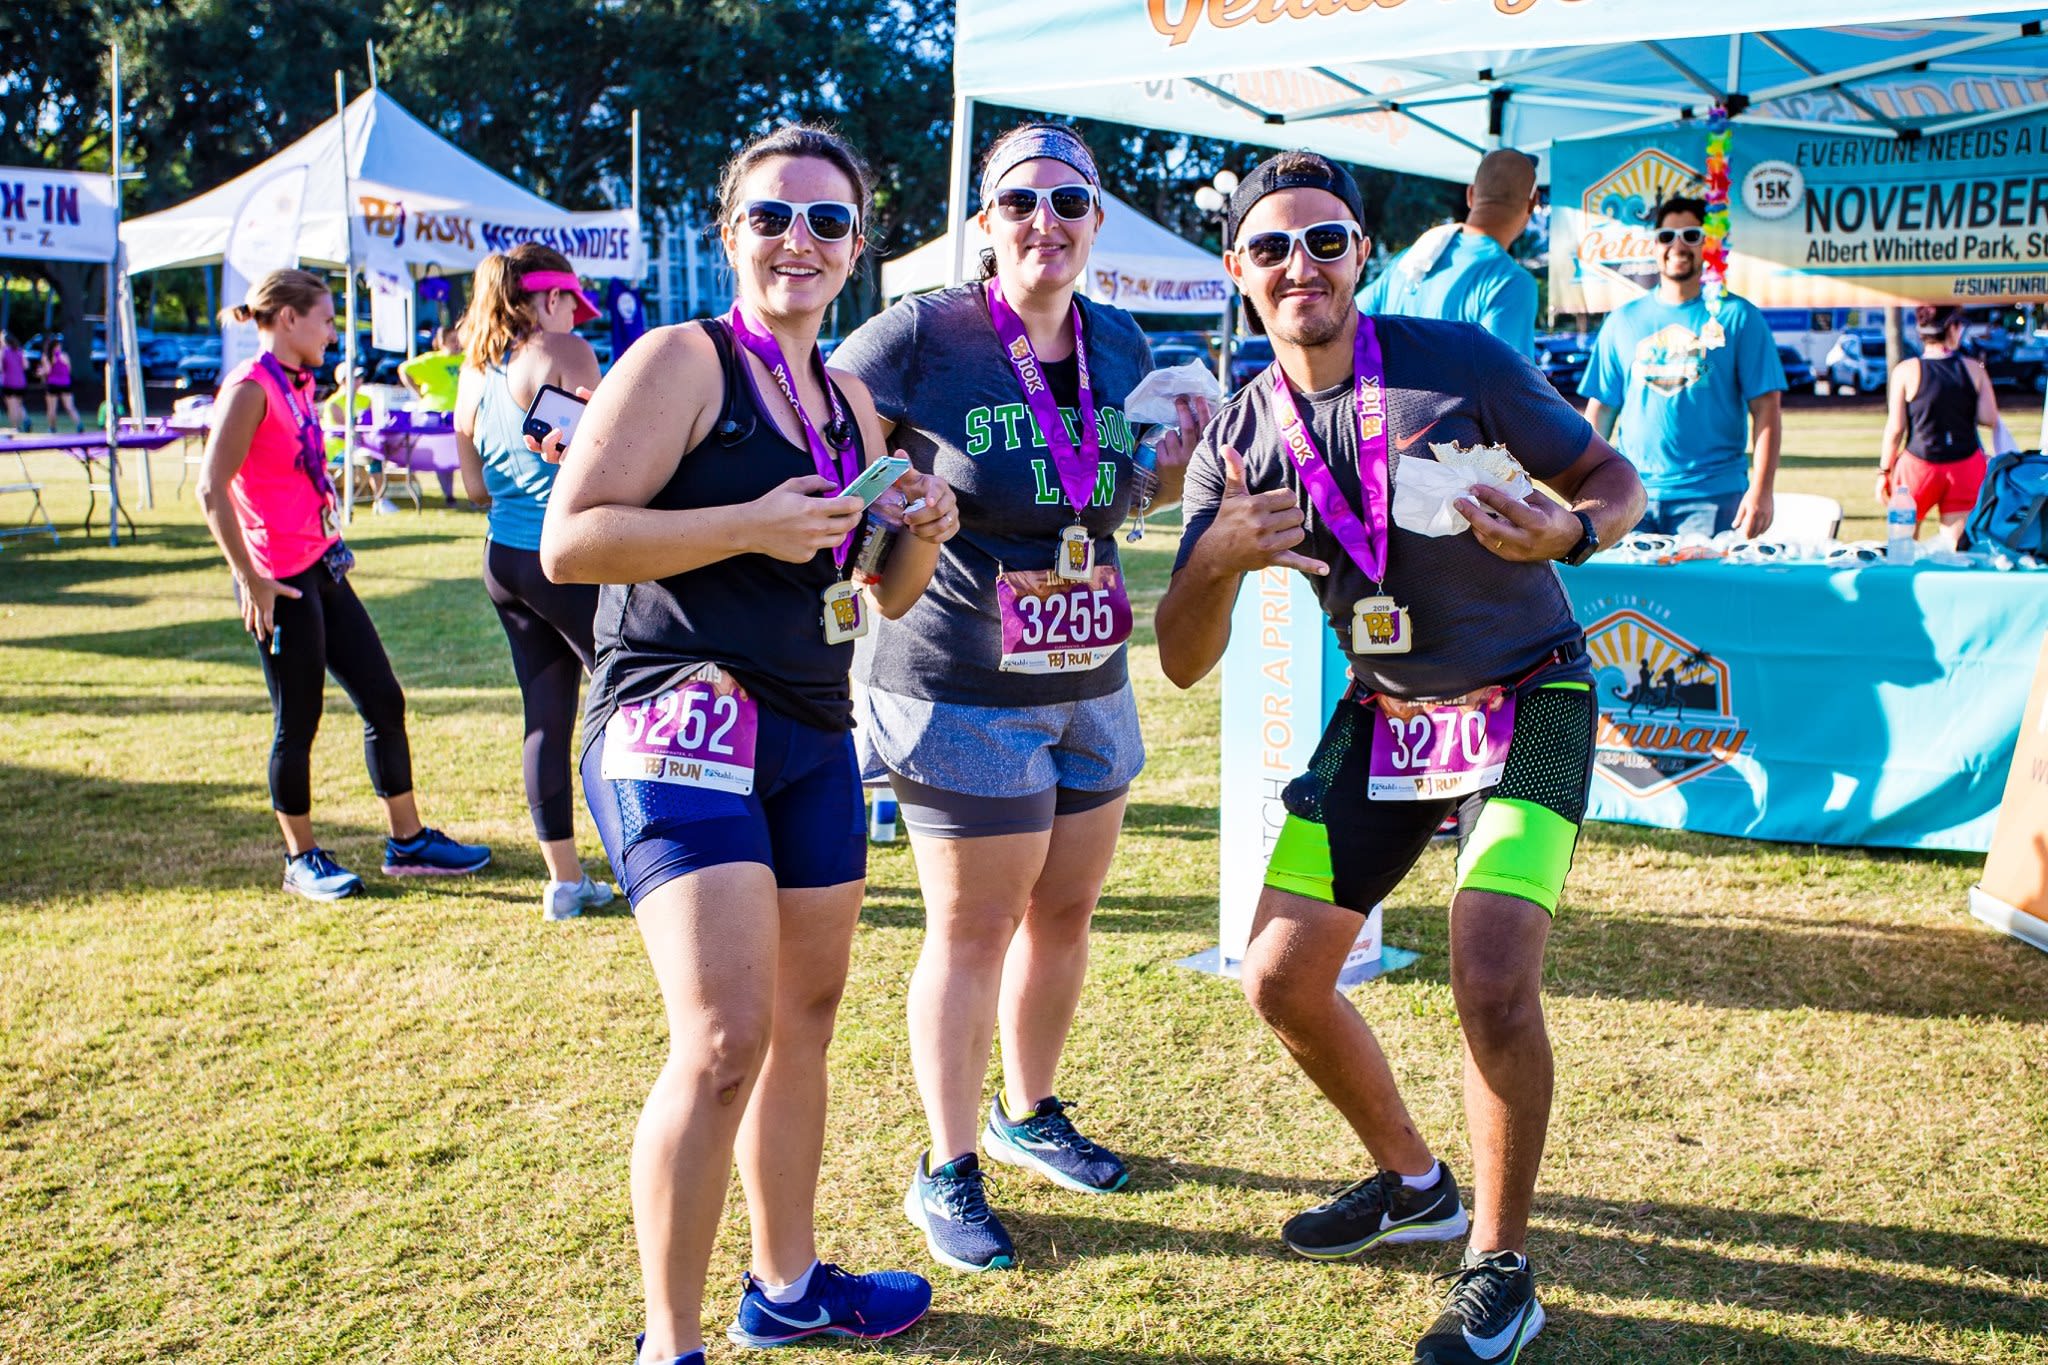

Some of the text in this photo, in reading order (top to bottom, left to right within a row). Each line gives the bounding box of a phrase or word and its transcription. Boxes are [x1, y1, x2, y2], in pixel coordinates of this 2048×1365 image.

[1797, 133, 1919, 167] EVERYONE
[1927, 126, 2009, 161] NEEDS
[2014, 127, 2031, 155] A
[1755, 181, 1790, 199] 15K
[1805, 177, 2048, 233] NOVEMBER
[415, 211, 474, 251] RUN
[1806, 239, 1868, 263] Albert
[1874, 236, 1958, 262] Whitted
[1964, 233, 2020, 261] Park,
[1031, 459, 1117, 507] LW
[1019, 590, 1114, 646] 3255
[1260, 565, 1292, 650] PRIZ
[1363, 610, 1400, 644] PBJ
[1371, 633, 1390, 645] RUN
[1047, 651, 1067, 670] PBJ
[1068, 651, 1092, 666] RUN
[1262, 657, 1291, 686] A
[620, 688, 738, 755] 3252
[1263, 694, 1292, 772] FOR
[1388, 710, 1488, 770] 3270
[668, 760, 703, 781] RUN
